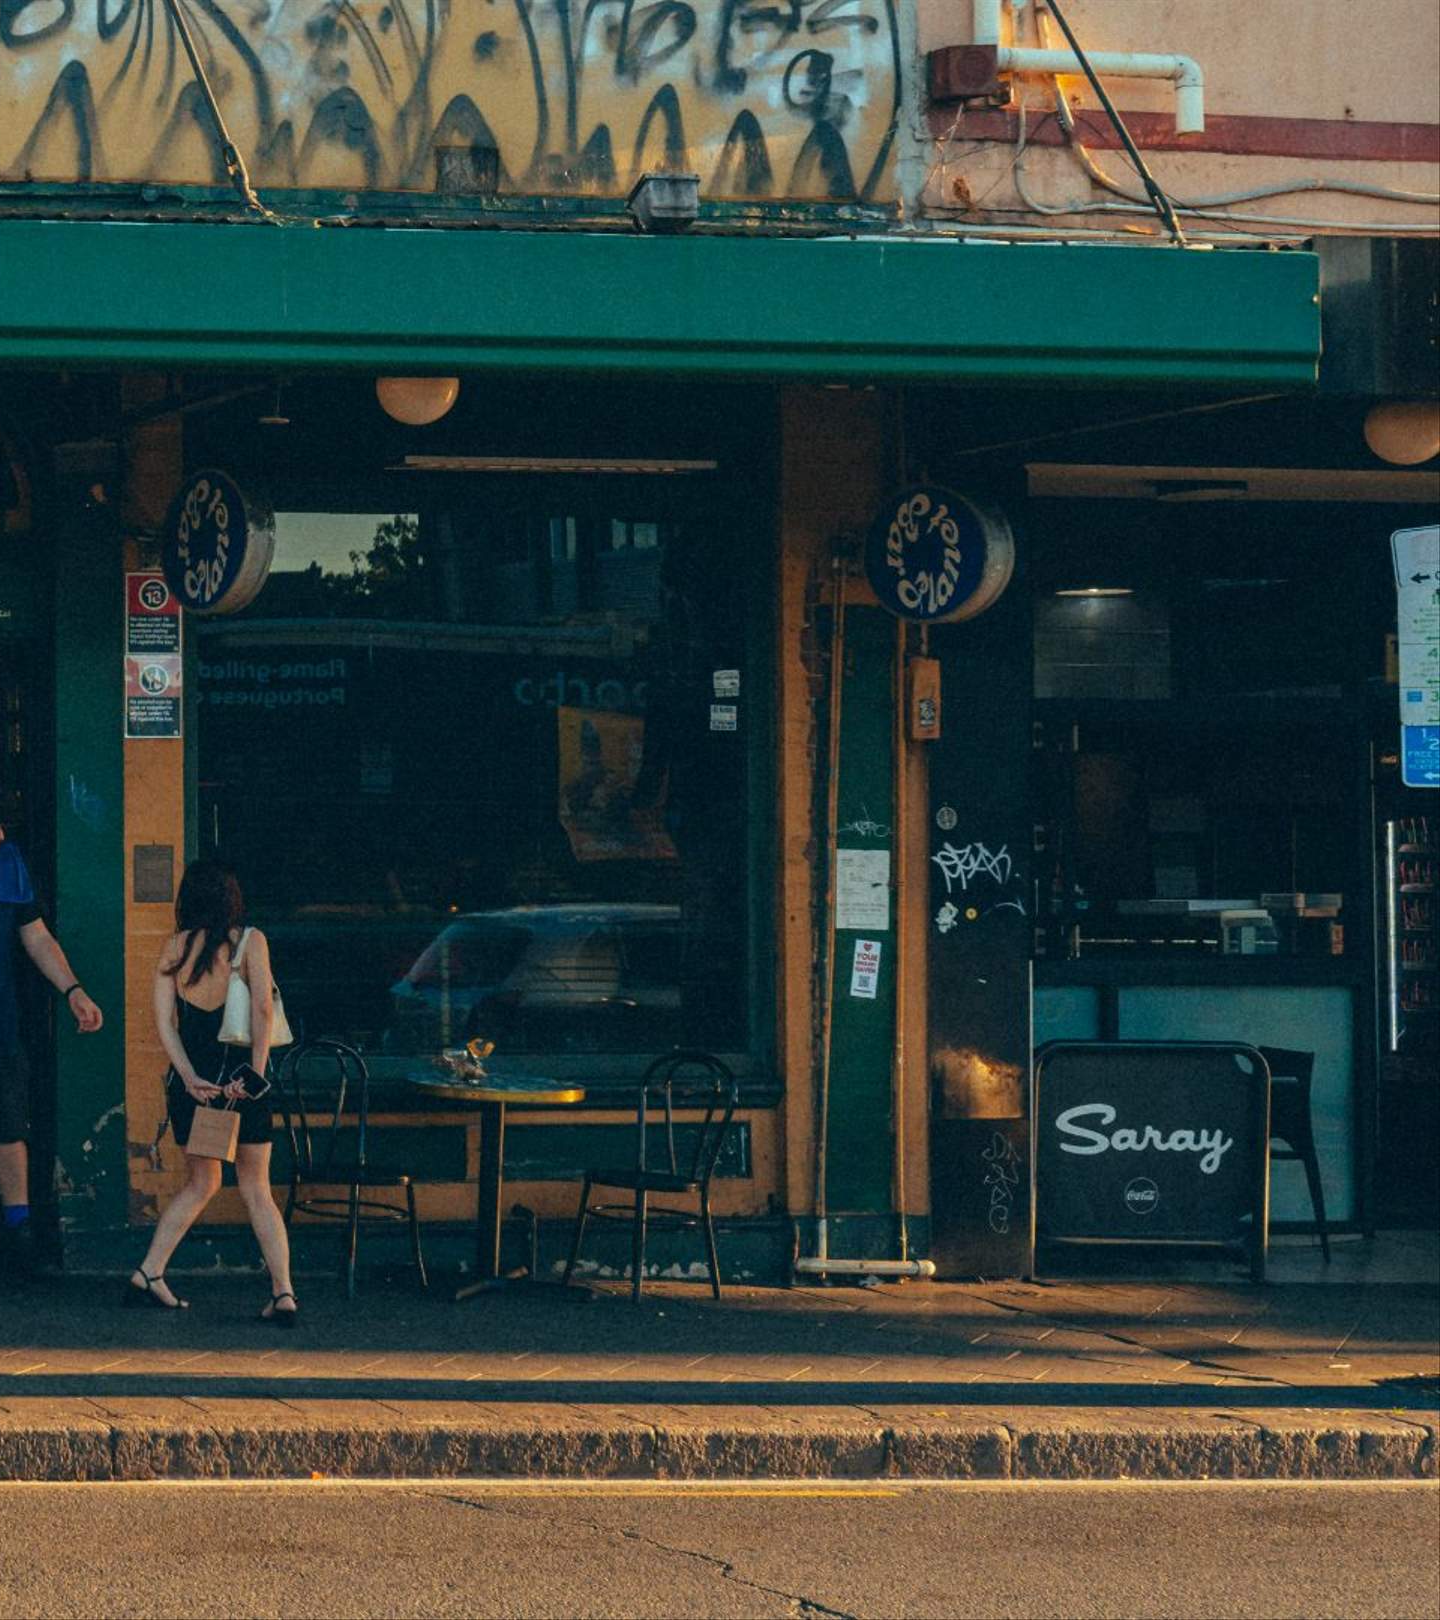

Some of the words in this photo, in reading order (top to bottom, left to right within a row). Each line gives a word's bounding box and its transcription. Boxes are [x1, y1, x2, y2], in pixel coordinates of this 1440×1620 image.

[177, 479, 210, 567] Bar
[886, 492, 931, 578] Bar
[896, 504, 962, 615] Planet
[145, 590, 162, 605] 18
[1055, 1103, 1233, 1175] Saray
